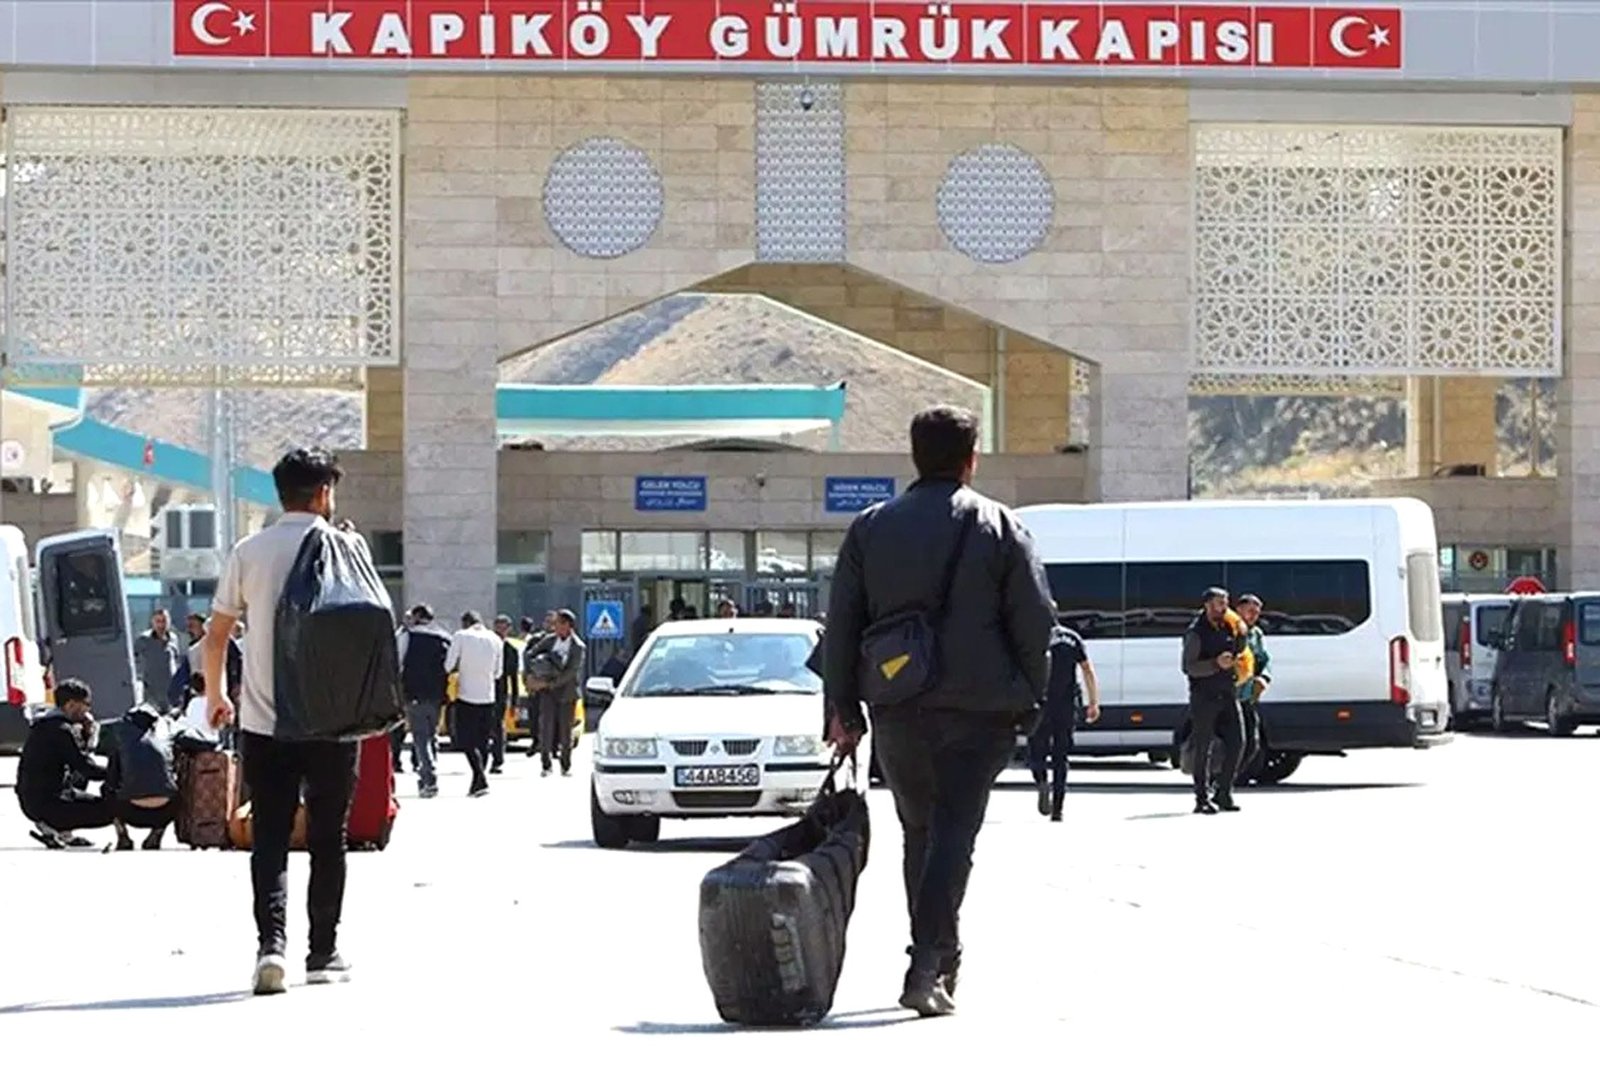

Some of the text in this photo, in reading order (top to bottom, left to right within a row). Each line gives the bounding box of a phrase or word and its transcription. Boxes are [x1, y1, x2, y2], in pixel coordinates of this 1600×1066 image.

[311, 2, 1274, 63] KAPIKÖY GÜMRÜK KAPISI
